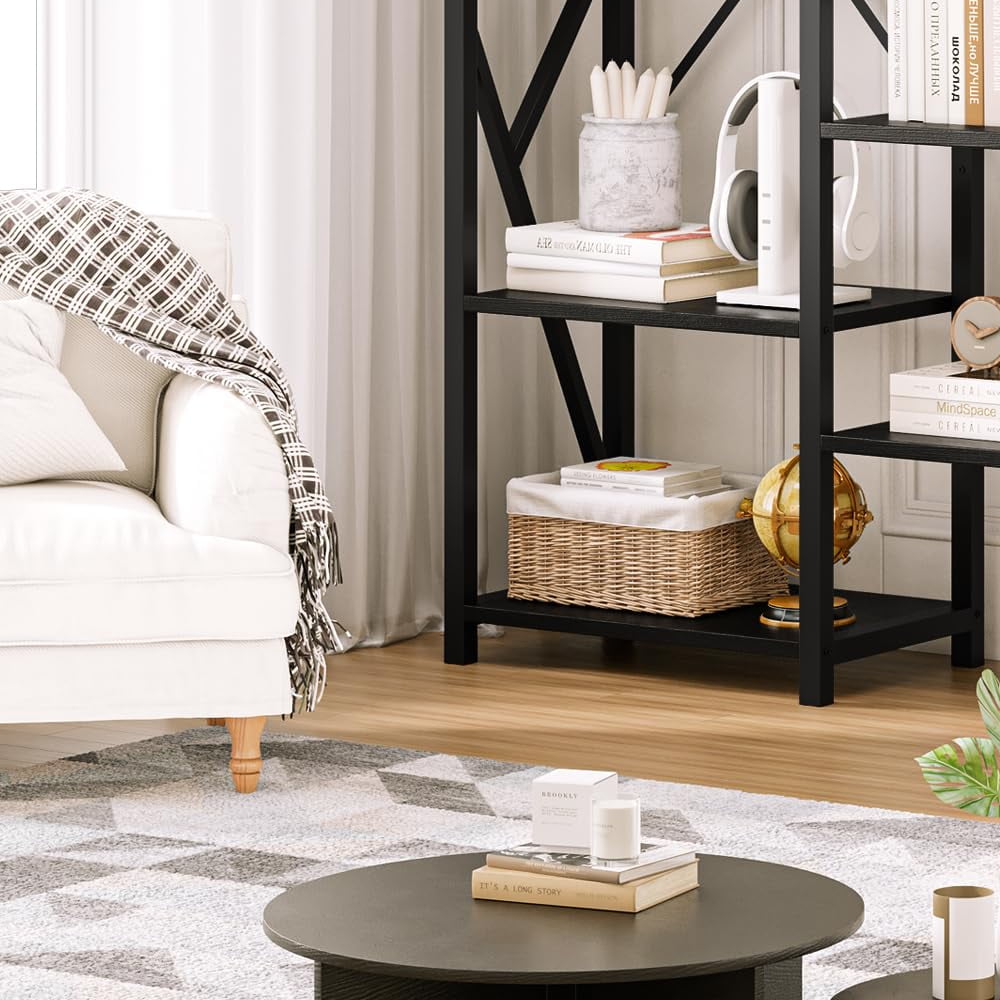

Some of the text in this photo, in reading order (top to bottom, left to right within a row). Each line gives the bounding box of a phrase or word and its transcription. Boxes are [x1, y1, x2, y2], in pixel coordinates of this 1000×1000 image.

[929, 15, 940, 97] ПРЕДАННЫХ
[952, 36, 960, 102] ШОКОЛАД
[968, 62, 979, 105] ЛУЧШЕ
[936, 401, 997, 418] MindSpace
[480, 881, 498, 890] IT'S
[512, 885, 533, 894] LONG
[537, 887, 561, 896] STORY
